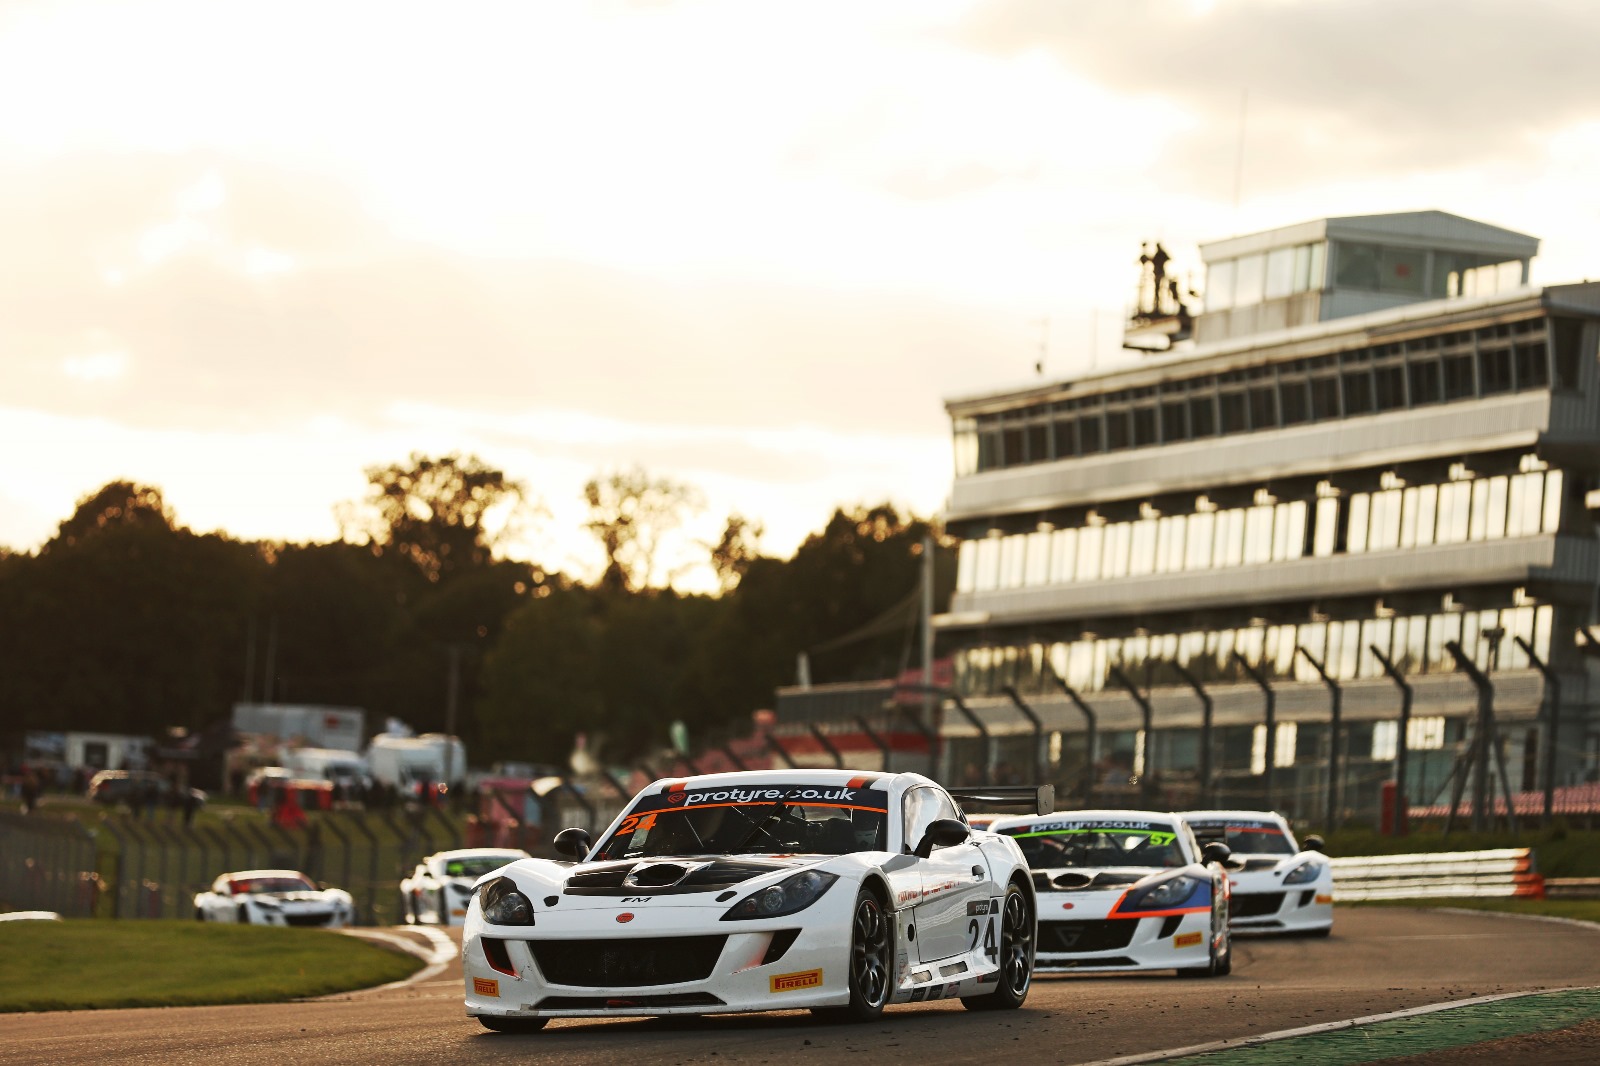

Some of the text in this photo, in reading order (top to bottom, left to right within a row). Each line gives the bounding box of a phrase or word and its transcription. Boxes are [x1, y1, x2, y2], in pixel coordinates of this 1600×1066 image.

[684, 787, 856, 807] protyre.co.uk
[614, 813, 658, 837] 24
[1150, 832, 1178, 846] 57
[968, 916, 999, 965] 24
[774, 972, 818, 990] PIRELLI
